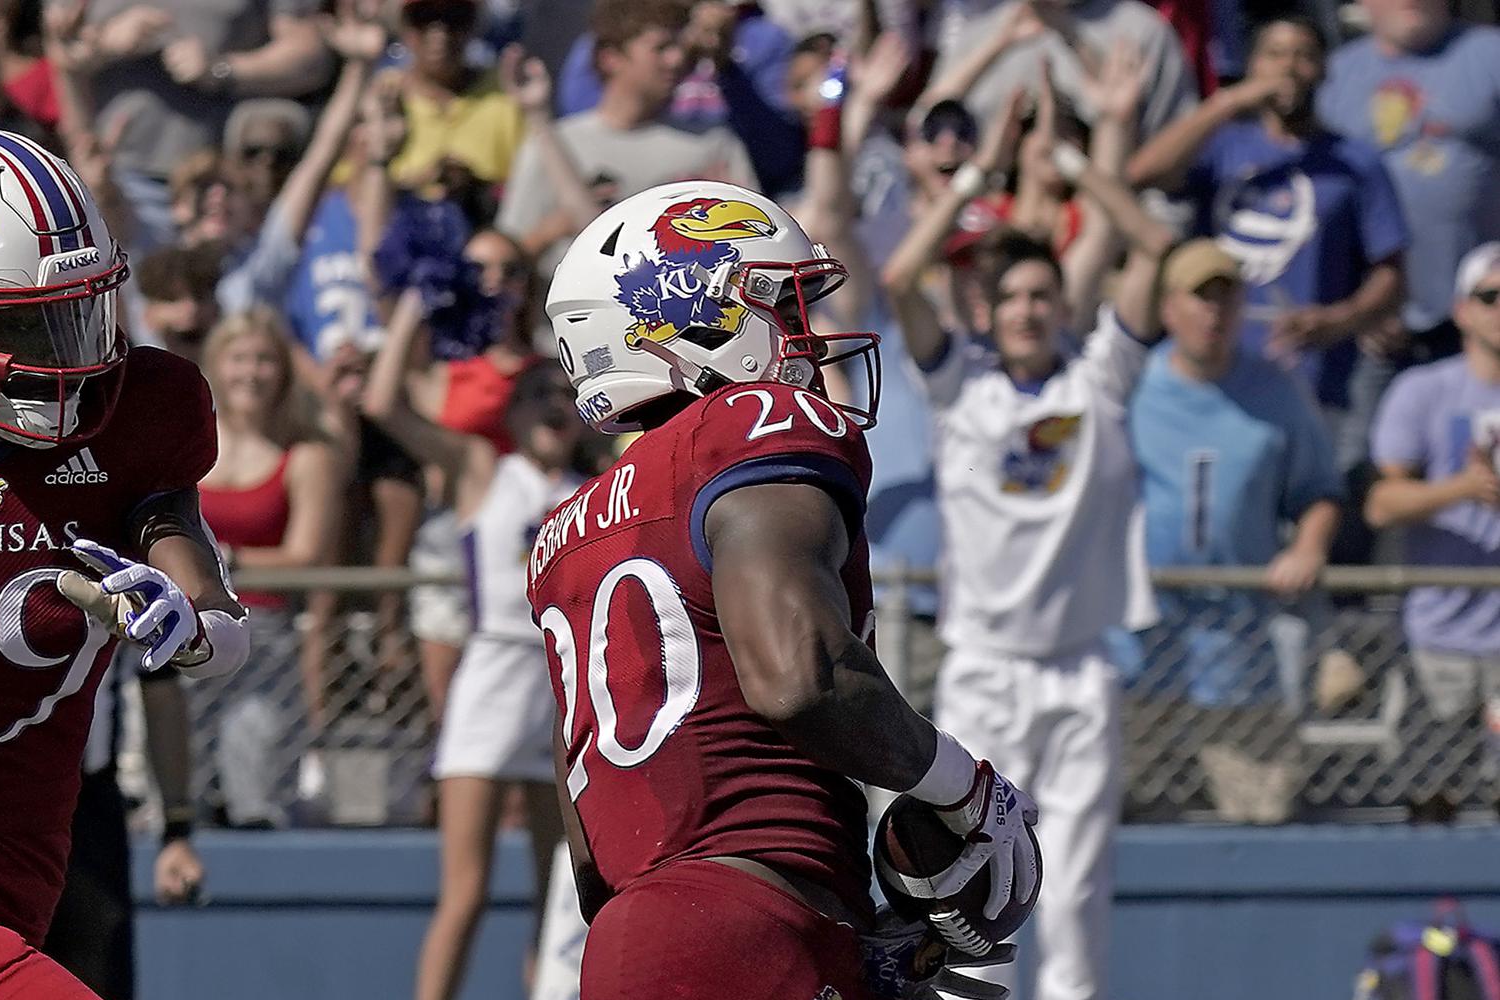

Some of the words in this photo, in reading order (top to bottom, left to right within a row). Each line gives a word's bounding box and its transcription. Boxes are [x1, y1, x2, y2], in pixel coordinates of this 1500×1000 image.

[655, 264, 701, 300] KU
[725, 389, 847, 441] 20
[45, 470, 109, 485] adidas
[596, 463, 640, 529] JR.
